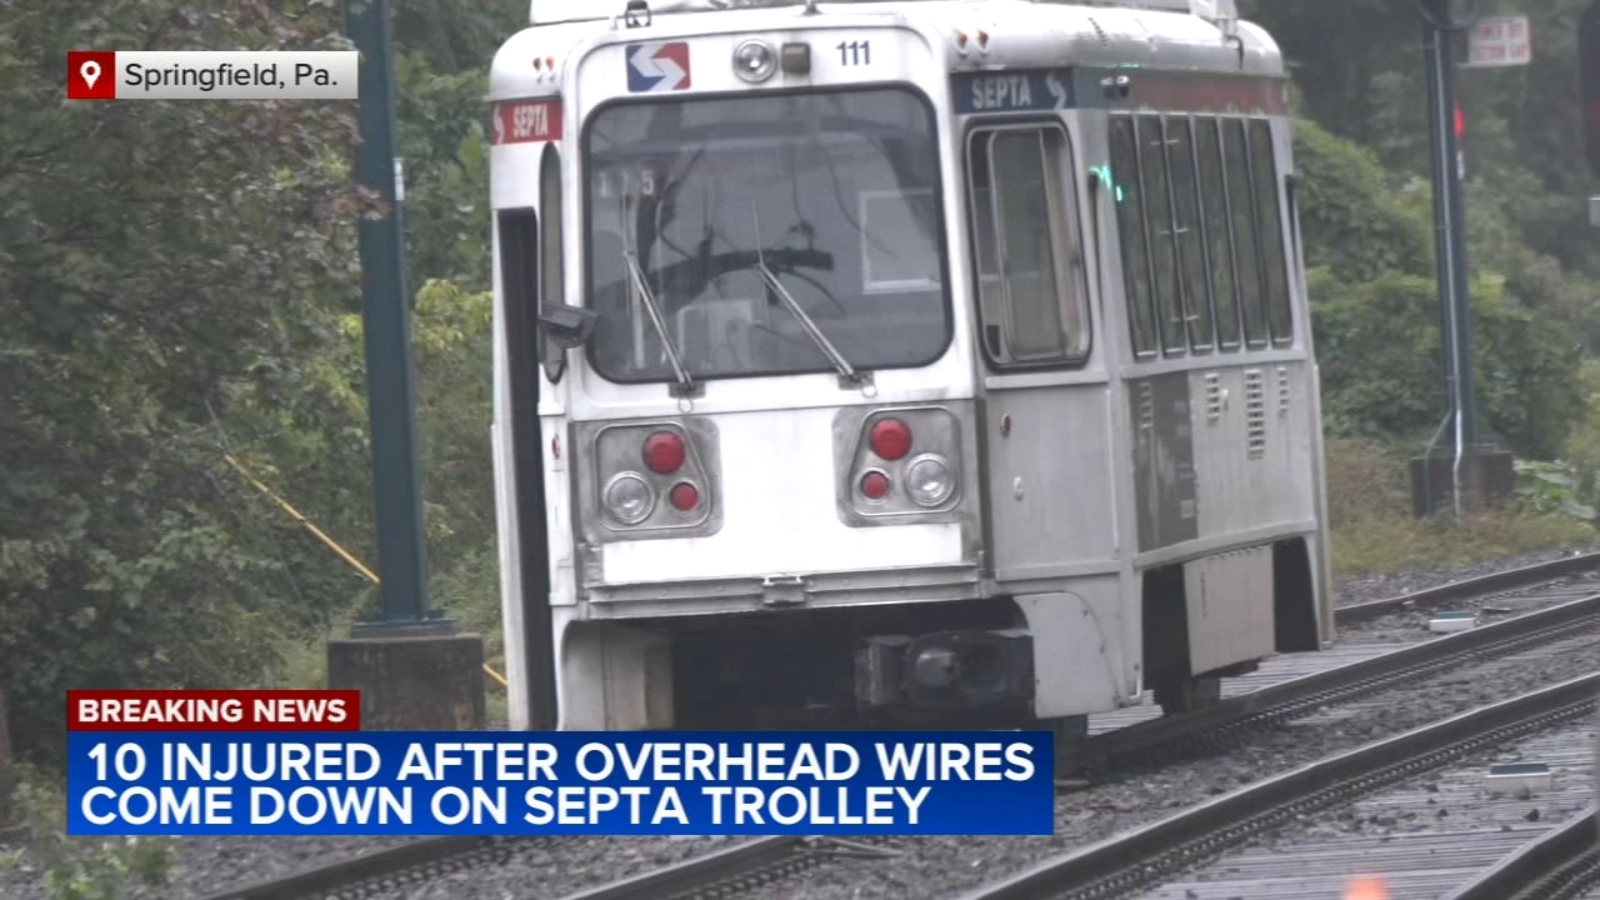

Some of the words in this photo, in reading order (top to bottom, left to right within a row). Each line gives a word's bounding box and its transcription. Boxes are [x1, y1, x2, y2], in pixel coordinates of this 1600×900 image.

[836, 40, 871, 66] 111
[971, 76, 1032, 109] SEPTA
[513, 104, 549, 138] SEPTA
